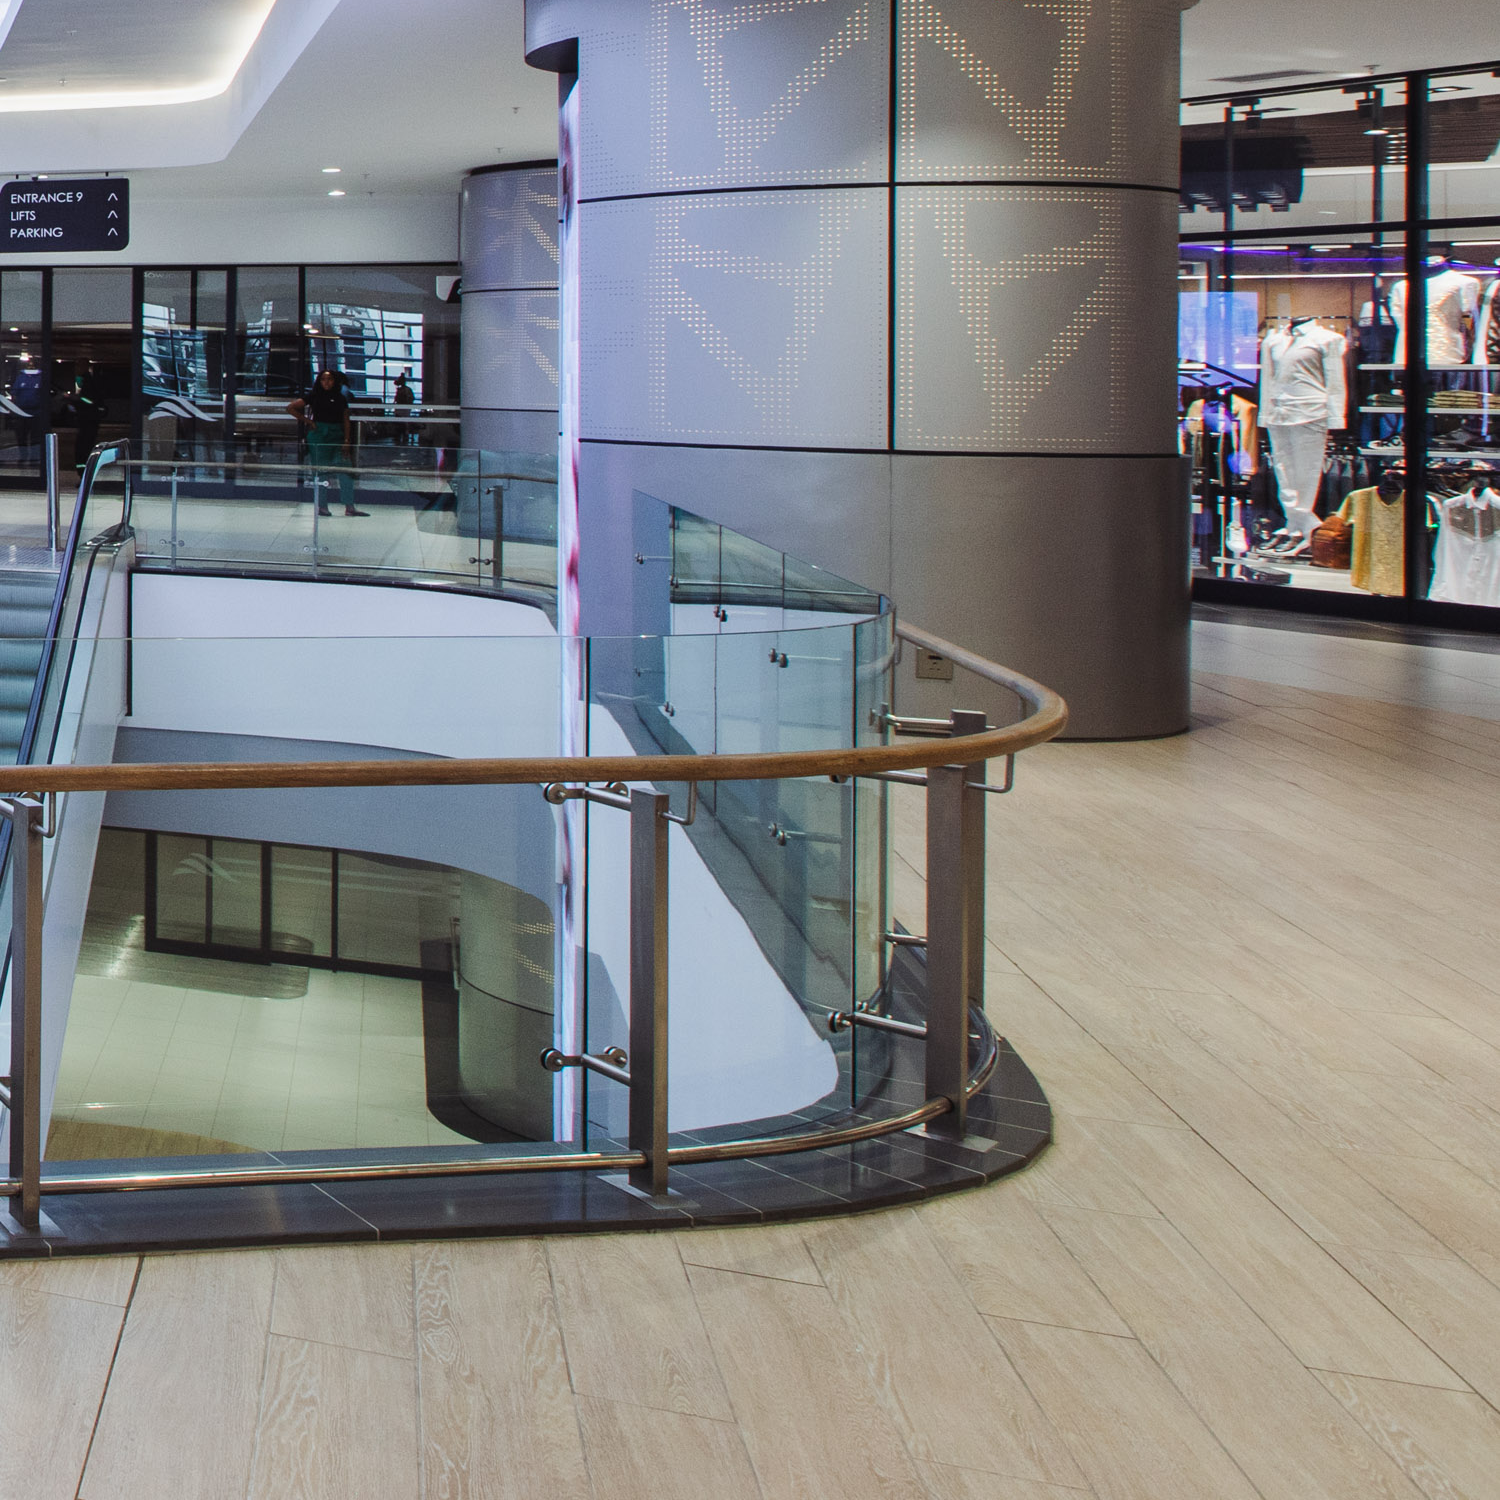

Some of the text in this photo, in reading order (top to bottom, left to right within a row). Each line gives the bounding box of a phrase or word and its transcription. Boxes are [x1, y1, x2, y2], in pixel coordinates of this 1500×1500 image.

[10, 191, 83, 204] ENTRANCE 9
[10, 210, 36, 221] LIFTS
[10, 227, 63, 238] PARKING
